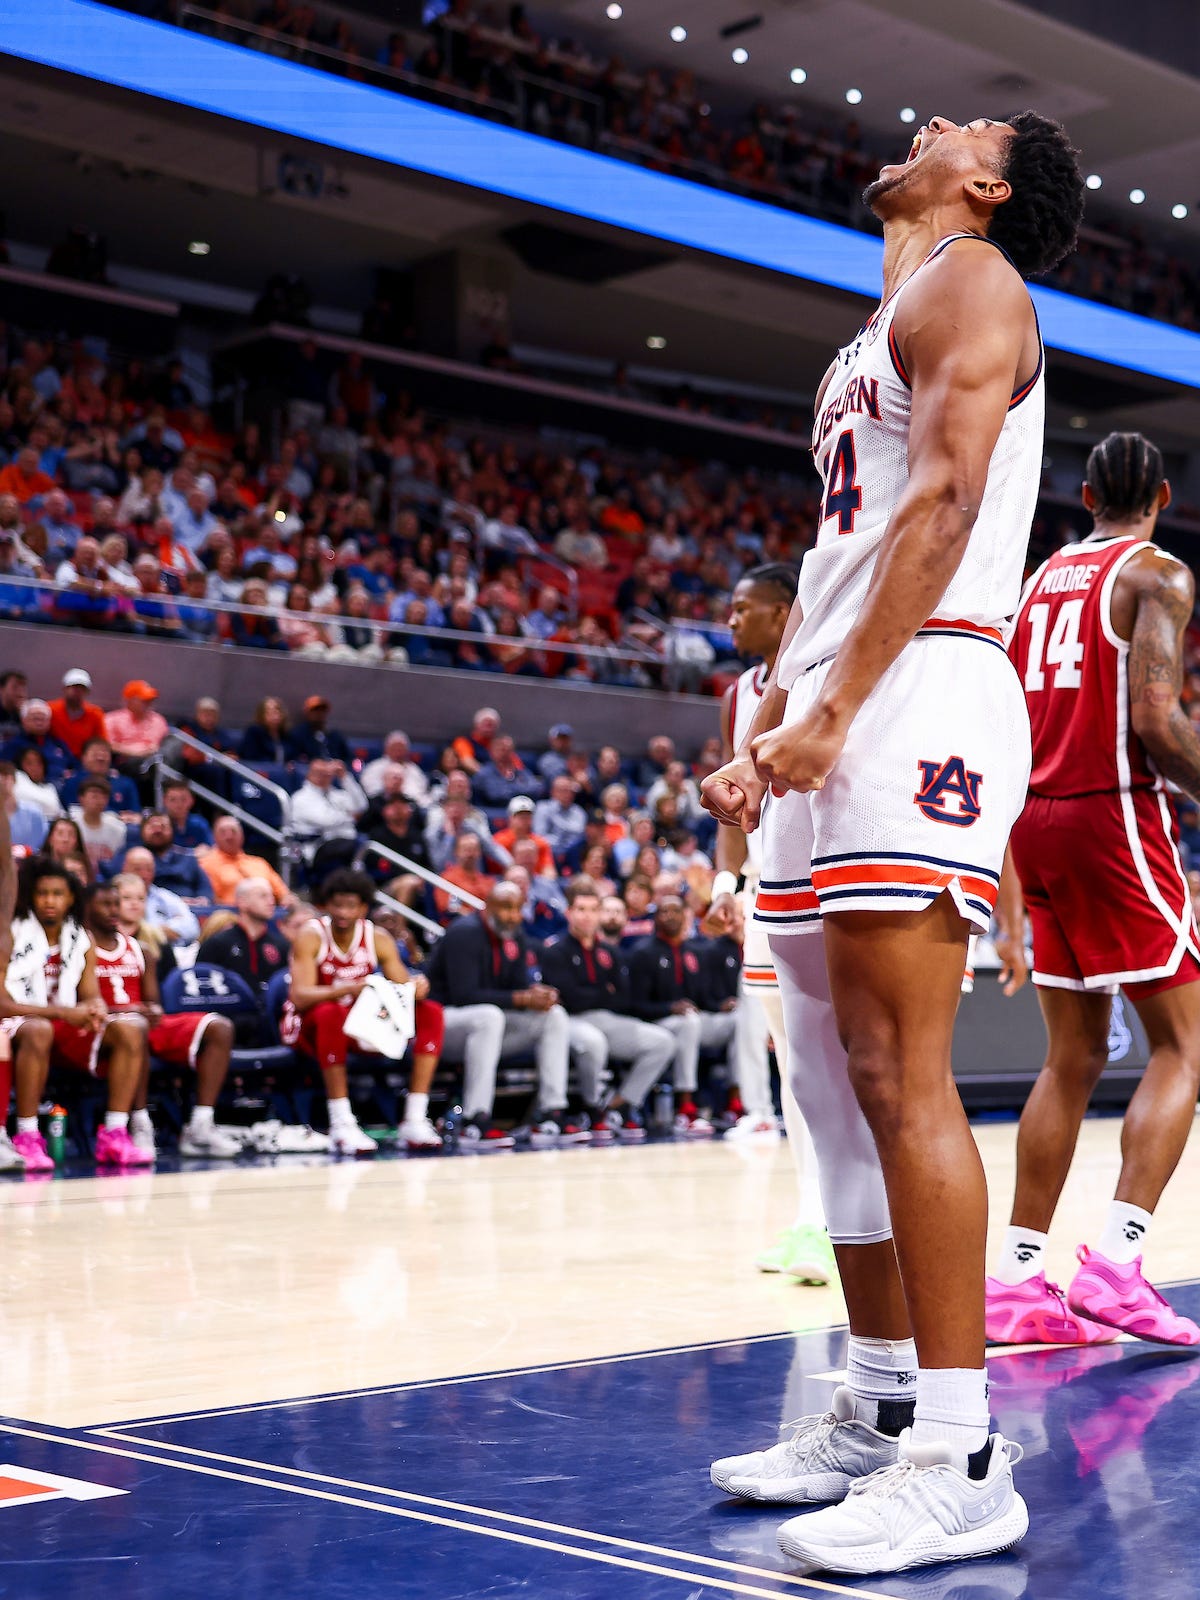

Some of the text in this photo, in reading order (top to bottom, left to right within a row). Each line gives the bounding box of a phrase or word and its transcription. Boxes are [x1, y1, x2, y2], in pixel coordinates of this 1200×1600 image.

[812, 375, 882, 456] UBURN
[1036, 563, 1100, 596] MOORE
[1024, 598, 1085, 693] 14
